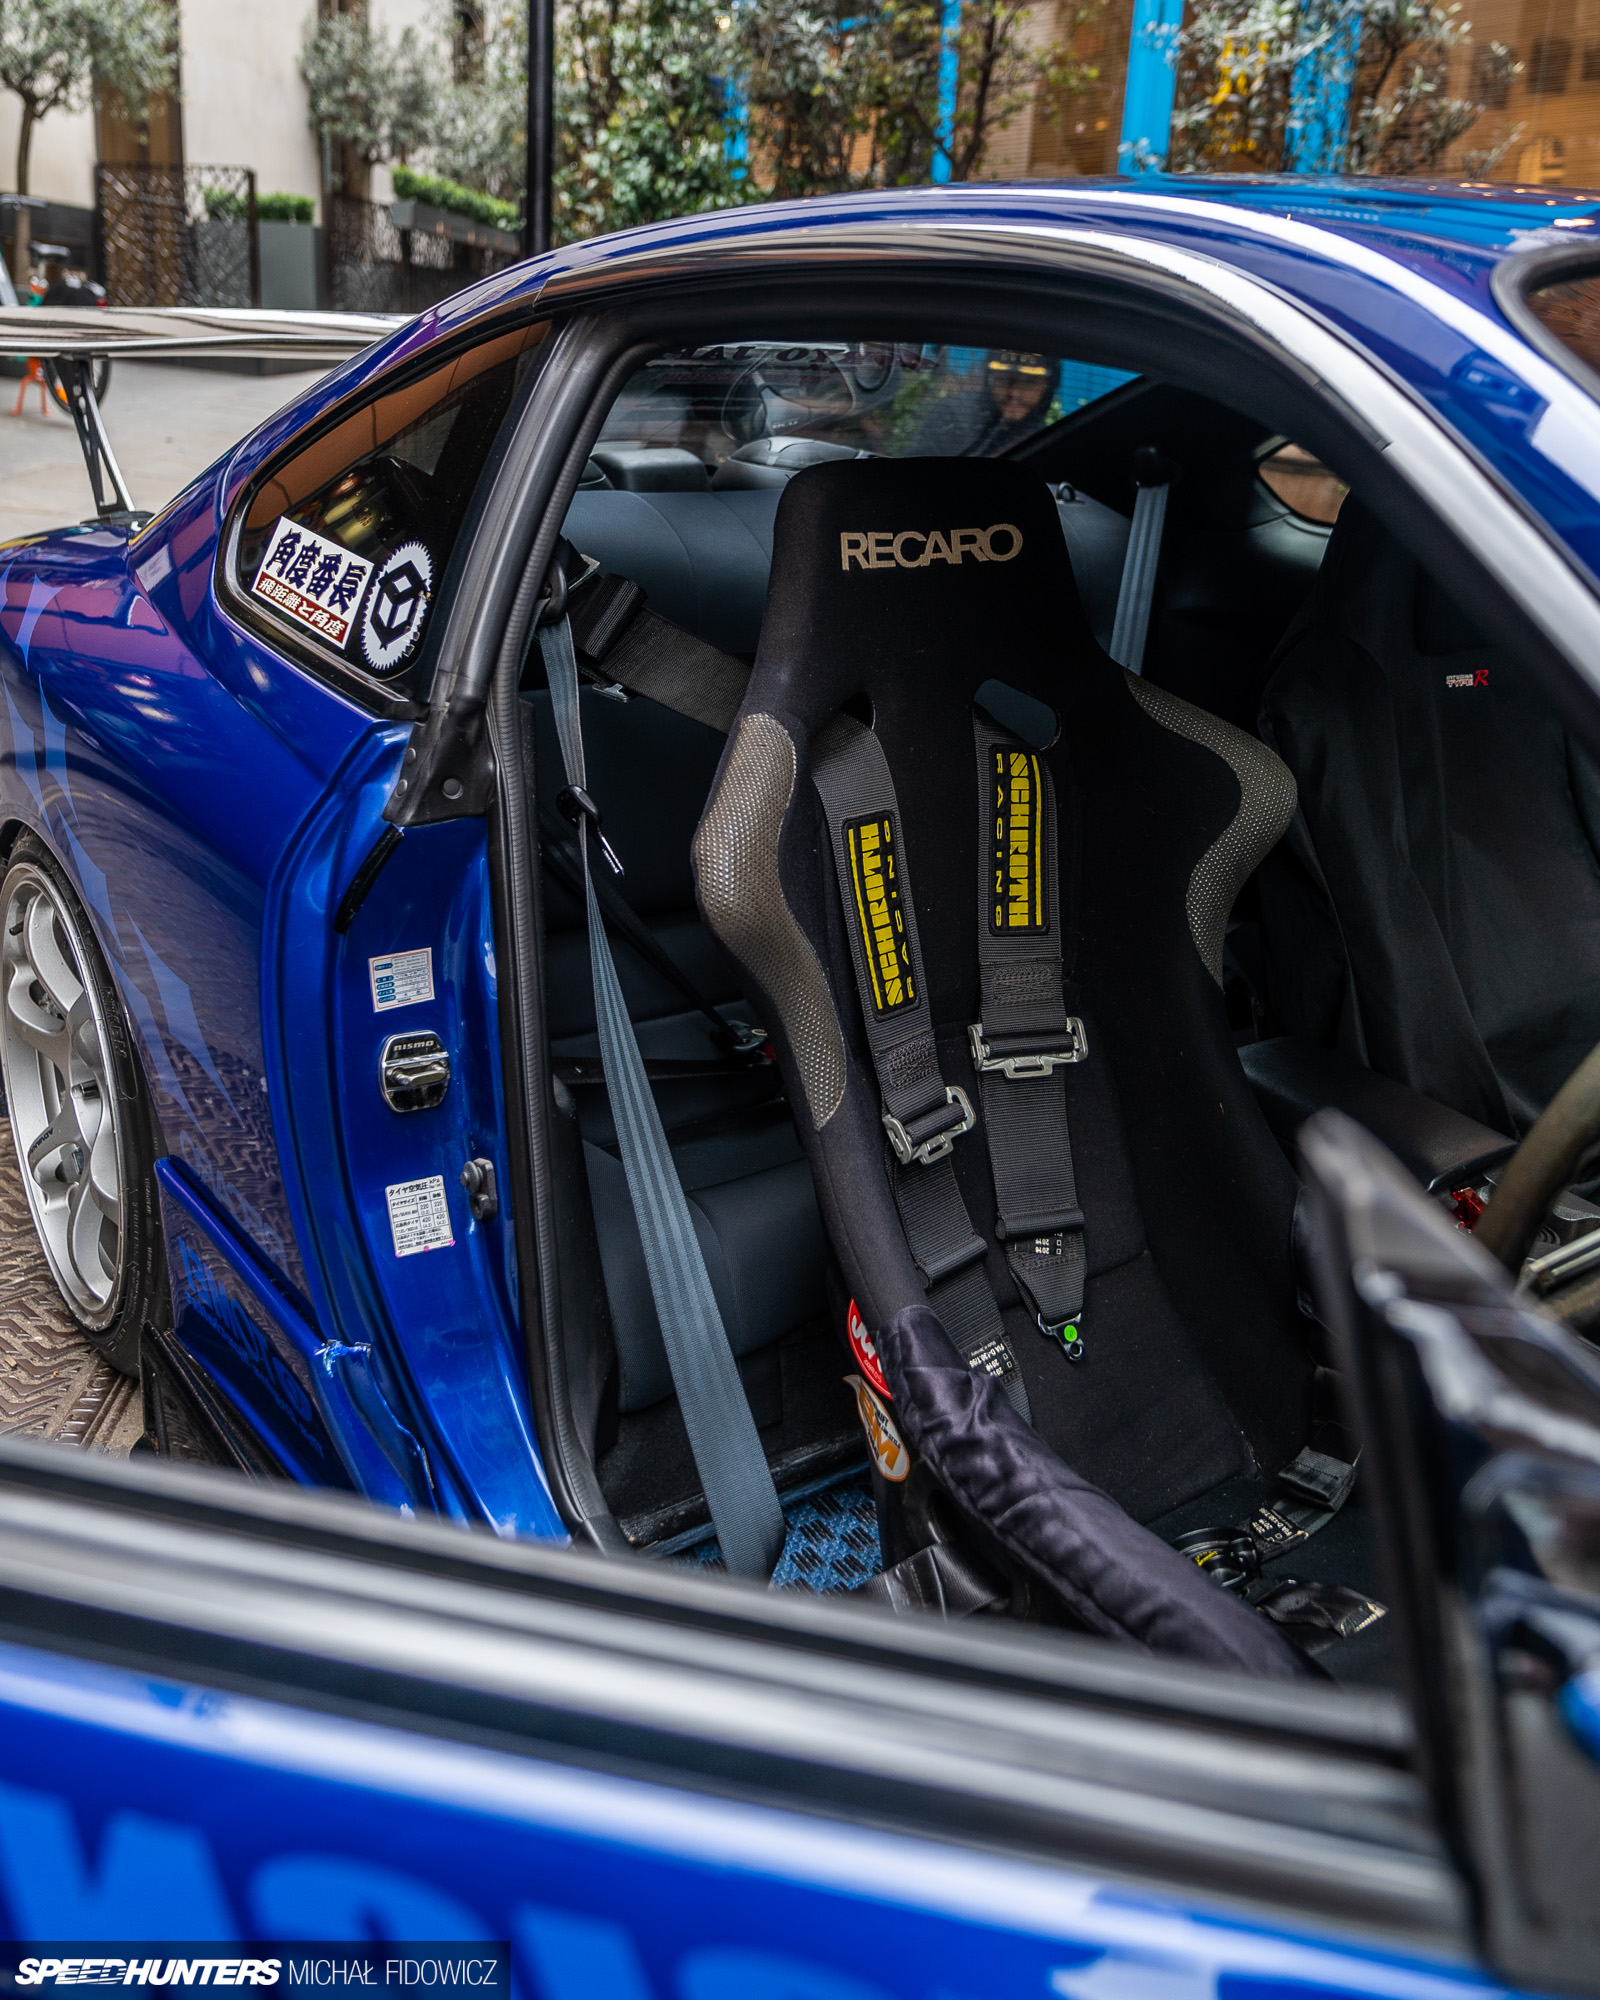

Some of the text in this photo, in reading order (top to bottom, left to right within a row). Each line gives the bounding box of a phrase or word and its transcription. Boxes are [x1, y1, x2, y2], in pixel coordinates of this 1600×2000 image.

[265, 528, 367, 615] 角度番長
[841, 523, 1023, 571] RECARO
[1473, 669, 1489, 687] R
[995, 753, 1004, 927] RACING
[1009, 752, 1030, 927] SCHROTH
[860, 822, 903, 1005] SCHROTH
[884, 820, 914, 998] RACING
[394, 1040, 434, 1051] nismo
[389, 1182, 428, 1197] タイヤ空気圧
